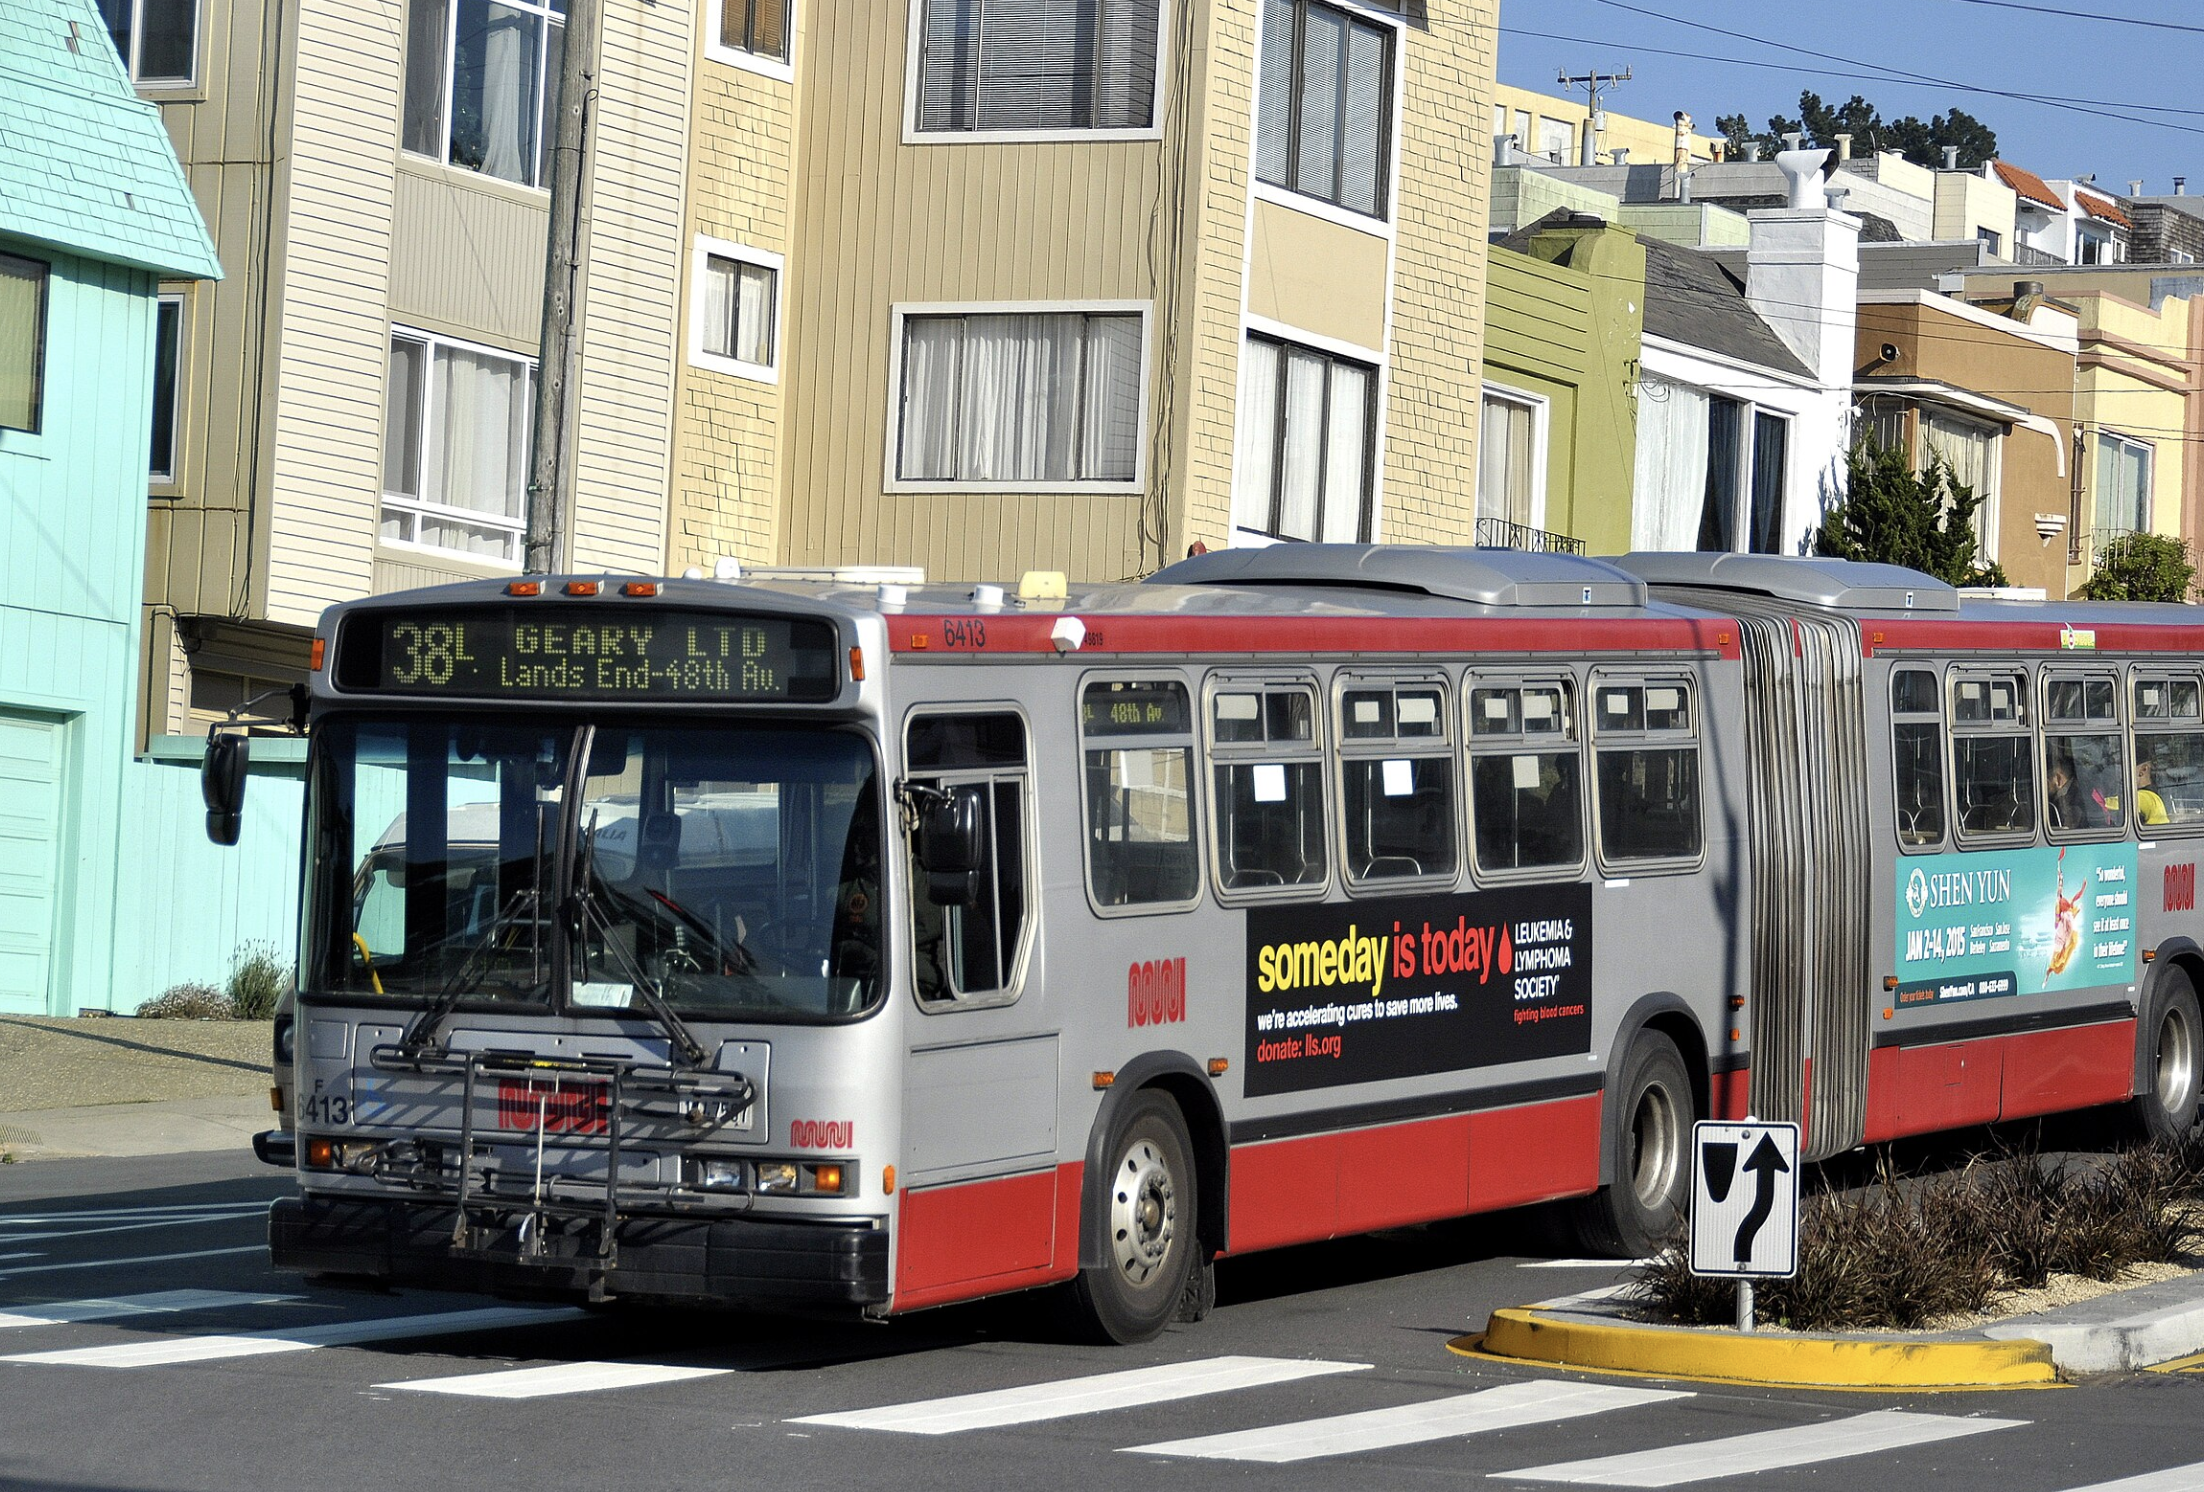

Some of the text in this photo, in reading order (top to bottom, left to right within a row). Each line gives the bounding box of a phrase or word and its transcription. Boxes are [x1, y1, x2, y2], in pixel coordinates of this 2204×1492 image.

[516, 624, 765, 657] GEARY LTD
[944, 619, 985, 647] 6413
[501, 656, 585, 687] Lands
[598, 658, 729, 690] End-48th
[1111, 703, 1140, 722] 48th
[1930, 869, 2011, 908] SHEN YUN
[1515, 918, 1573, 944] LEUKEMIA &
[1905, 926, 1966, 963] JAN 2-14, 2015
[1258, 915, 1496, 997] someday is today
[1515, 946, 1571, 972] LYMPHOMA
[1257, 991, 1459, 1031] we're accelerating cures to save more lives.
[1513, 1004, 1584, 1025] fighting blood cancers
[1257, 1033, 1342, 1063] donate: lls.org
[315, 1079, 323, 1093] F
[298, 1093, 348, 1125] 6413
